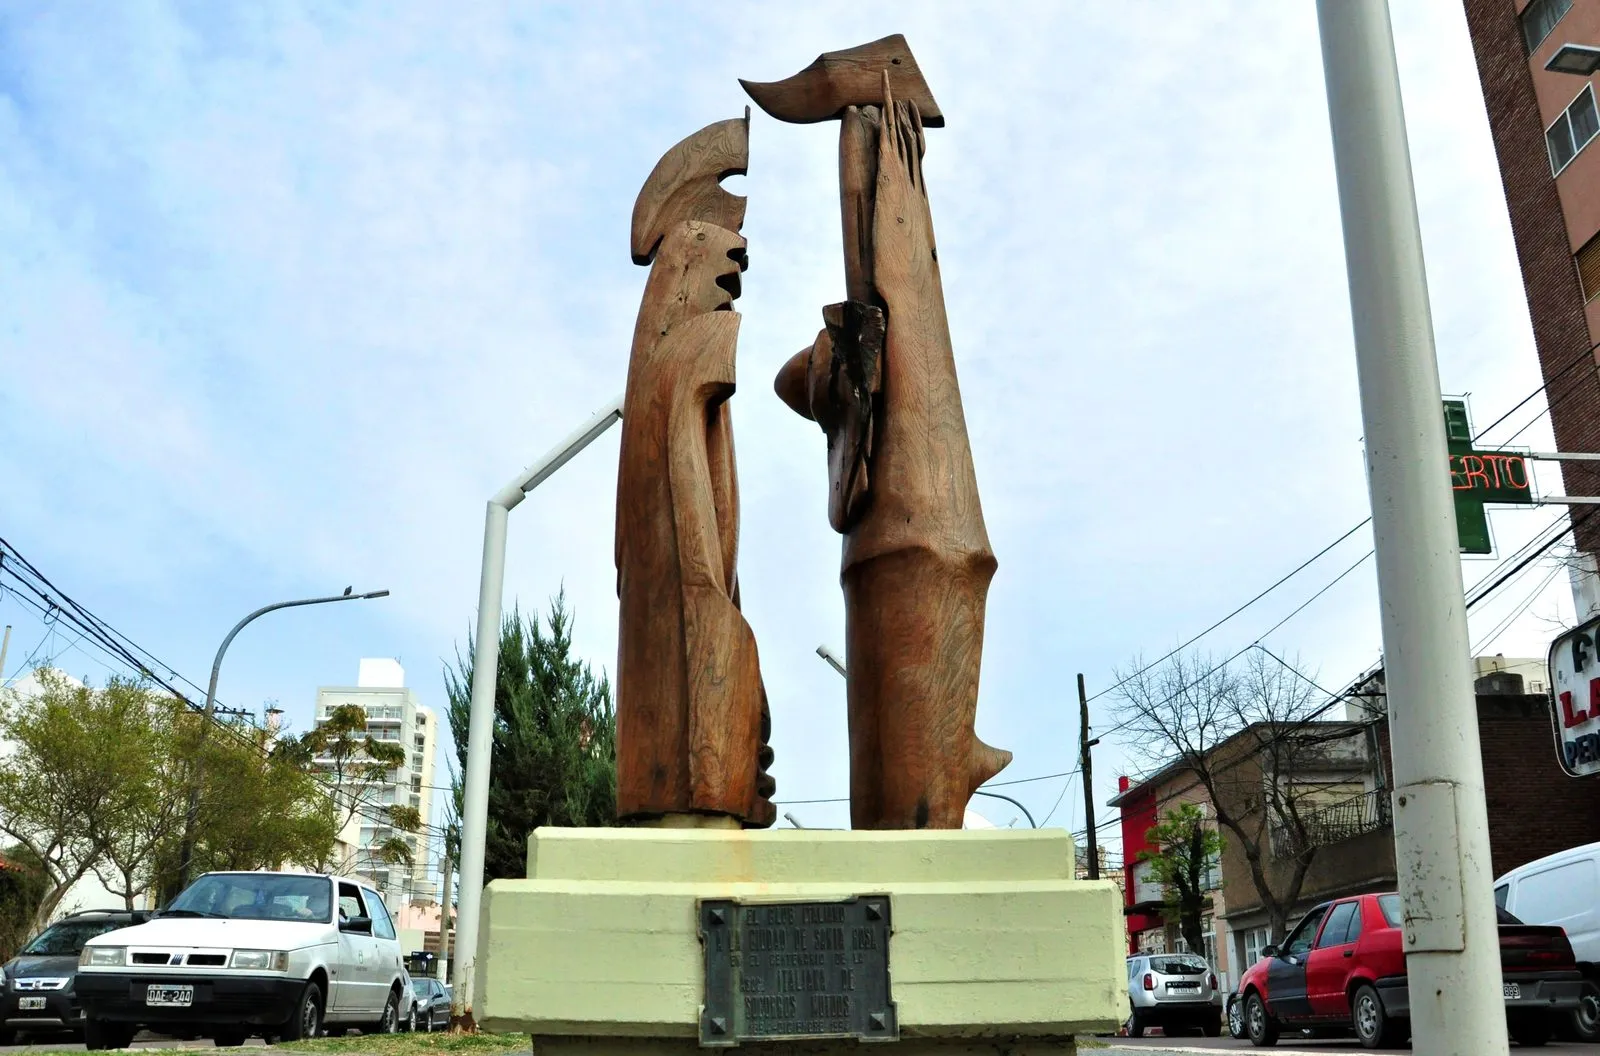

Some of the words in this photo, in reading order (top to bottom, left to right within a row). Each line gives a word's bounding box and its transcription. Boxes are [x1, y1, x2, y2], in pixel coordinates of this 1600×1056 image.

[1571, 623, 1600, 674] F
[1564, 729, 1600, 768] PER
[814, 927, 845, 951] SANTA
[777, 968, 826, 992] ITALIANA
